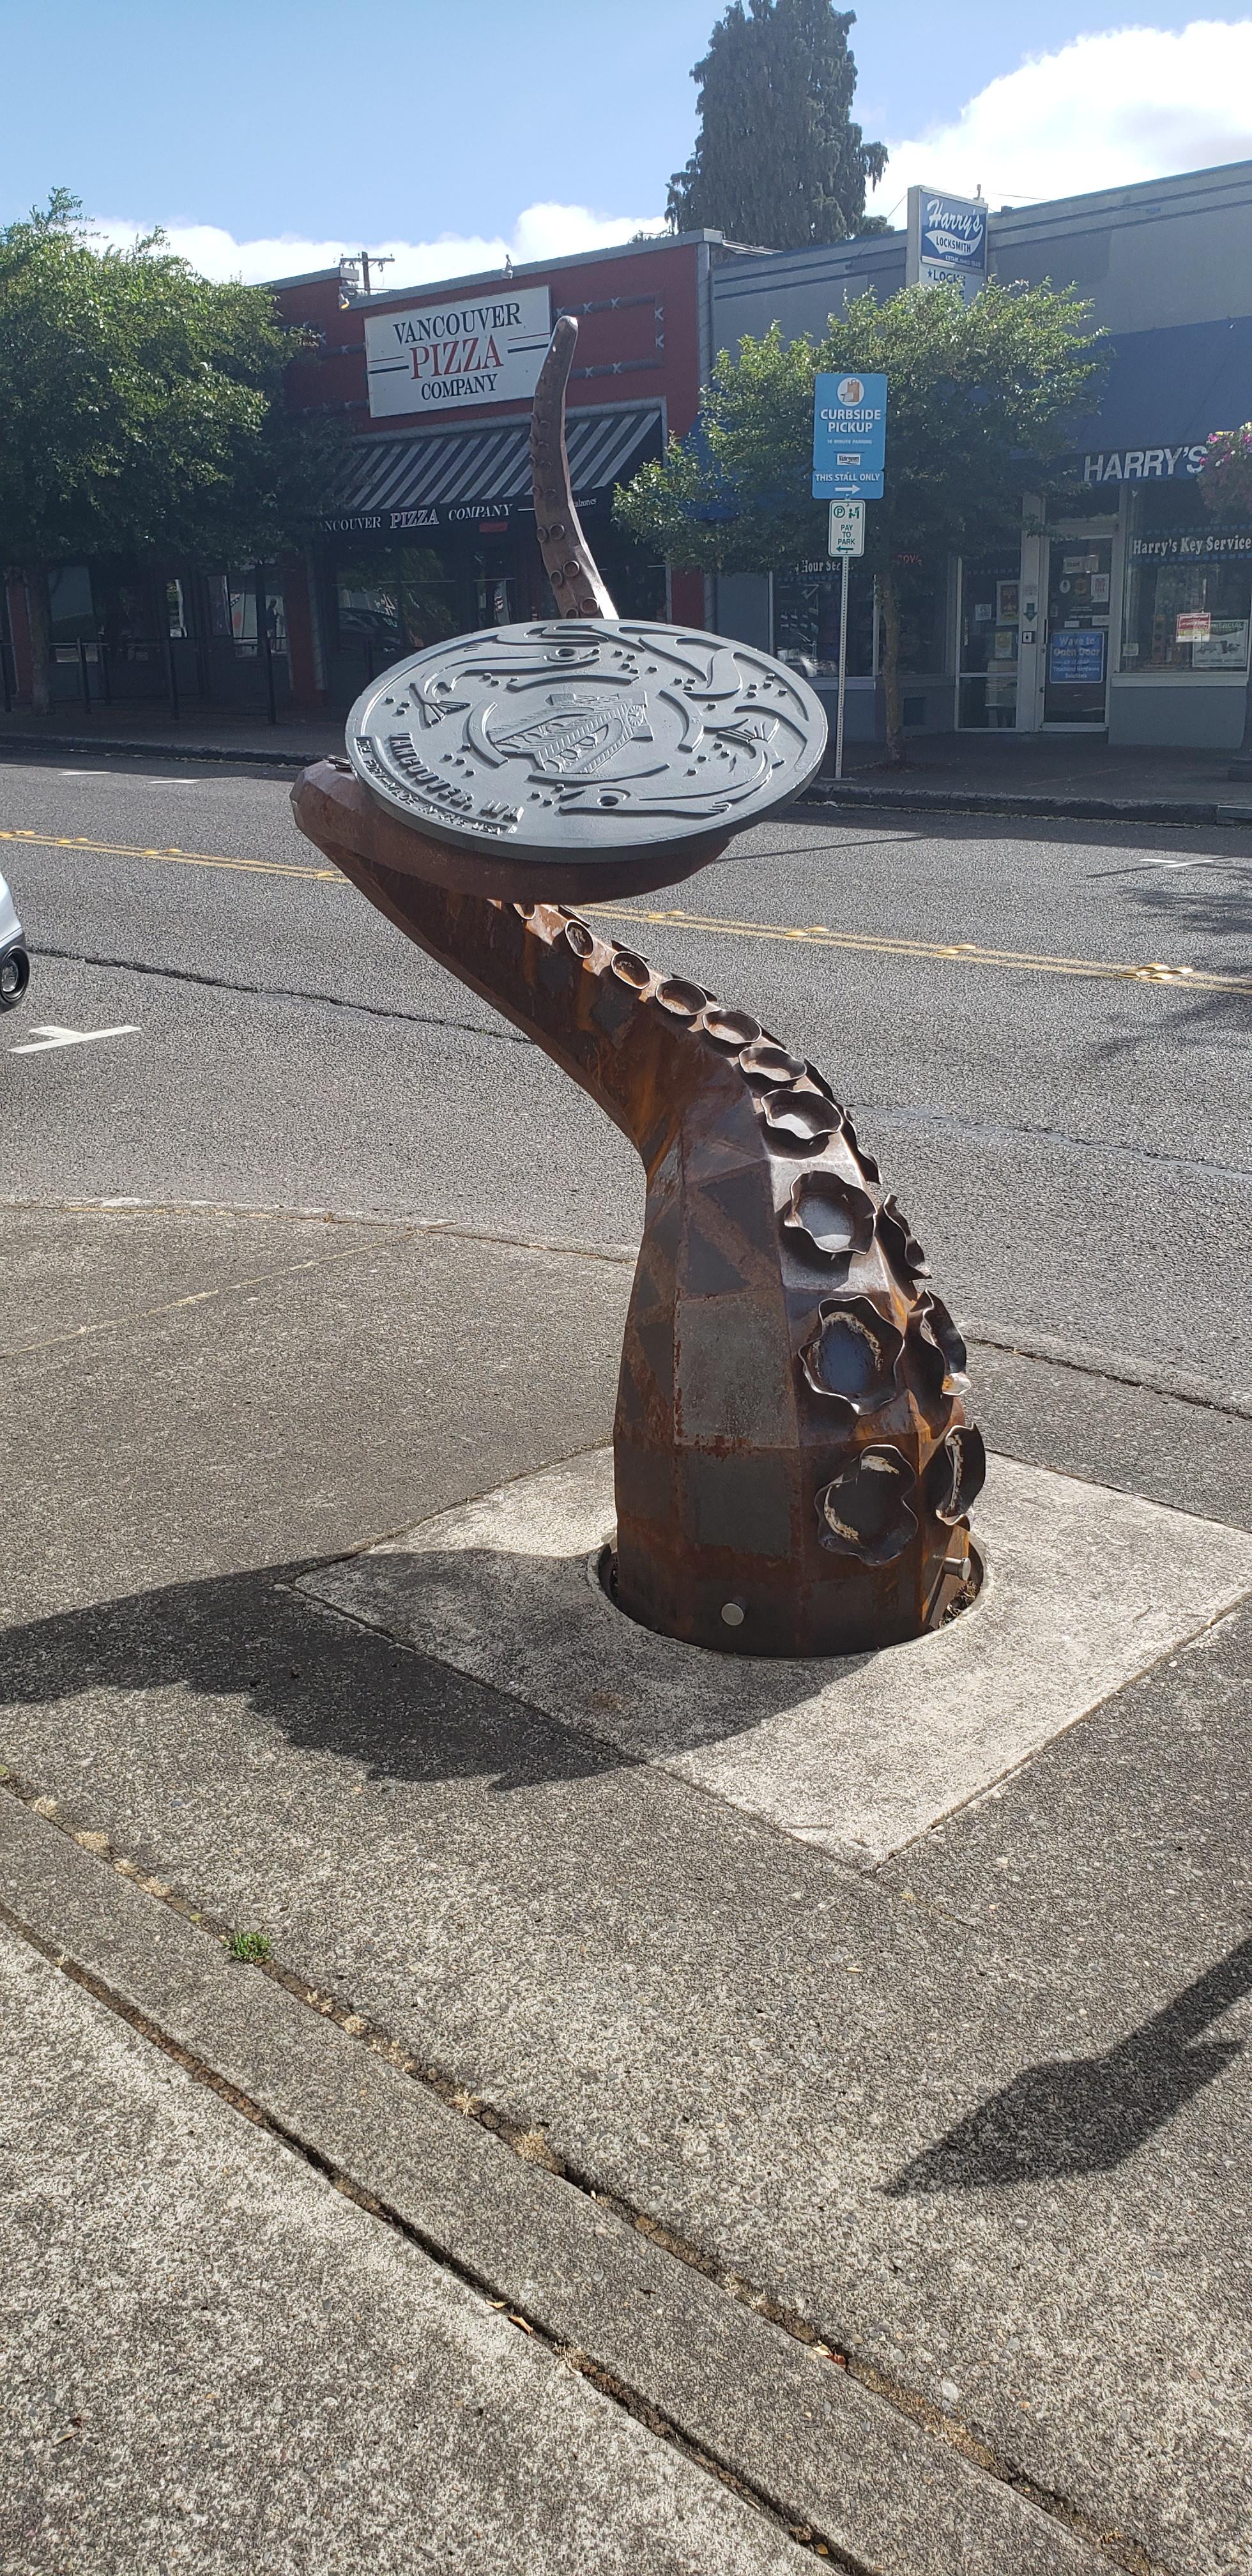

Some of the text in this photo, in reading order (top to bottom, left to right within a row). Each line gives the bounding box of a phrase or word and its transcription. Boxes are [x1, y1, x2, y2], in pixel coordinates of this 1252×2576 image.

[927, 199, 983, 240] Harry's
[936, 236, 971, 253] LOCKSMITH
[393, 302, 522, 345] VANCOUVER
[409, 334, 505, 380] PIZZA
[421, 373, 498, 401] COMPANY
[820, 409, 882, 420] CURBSIDE
[828, 422, 873, 433] PICKUP
[1083, 445, 1209, 482] HARRY'S
[815, 473, 880, 482] THIS STALL ONLY
[317, 515, 381, 532] NCOUVER
[390, 509, 439, 529] PIZZA
[448, 503, 513, 521] COMPANY
[1133, 535, 1252, 556] Harry's Key Service
[480, 800, 525, 823] WA
